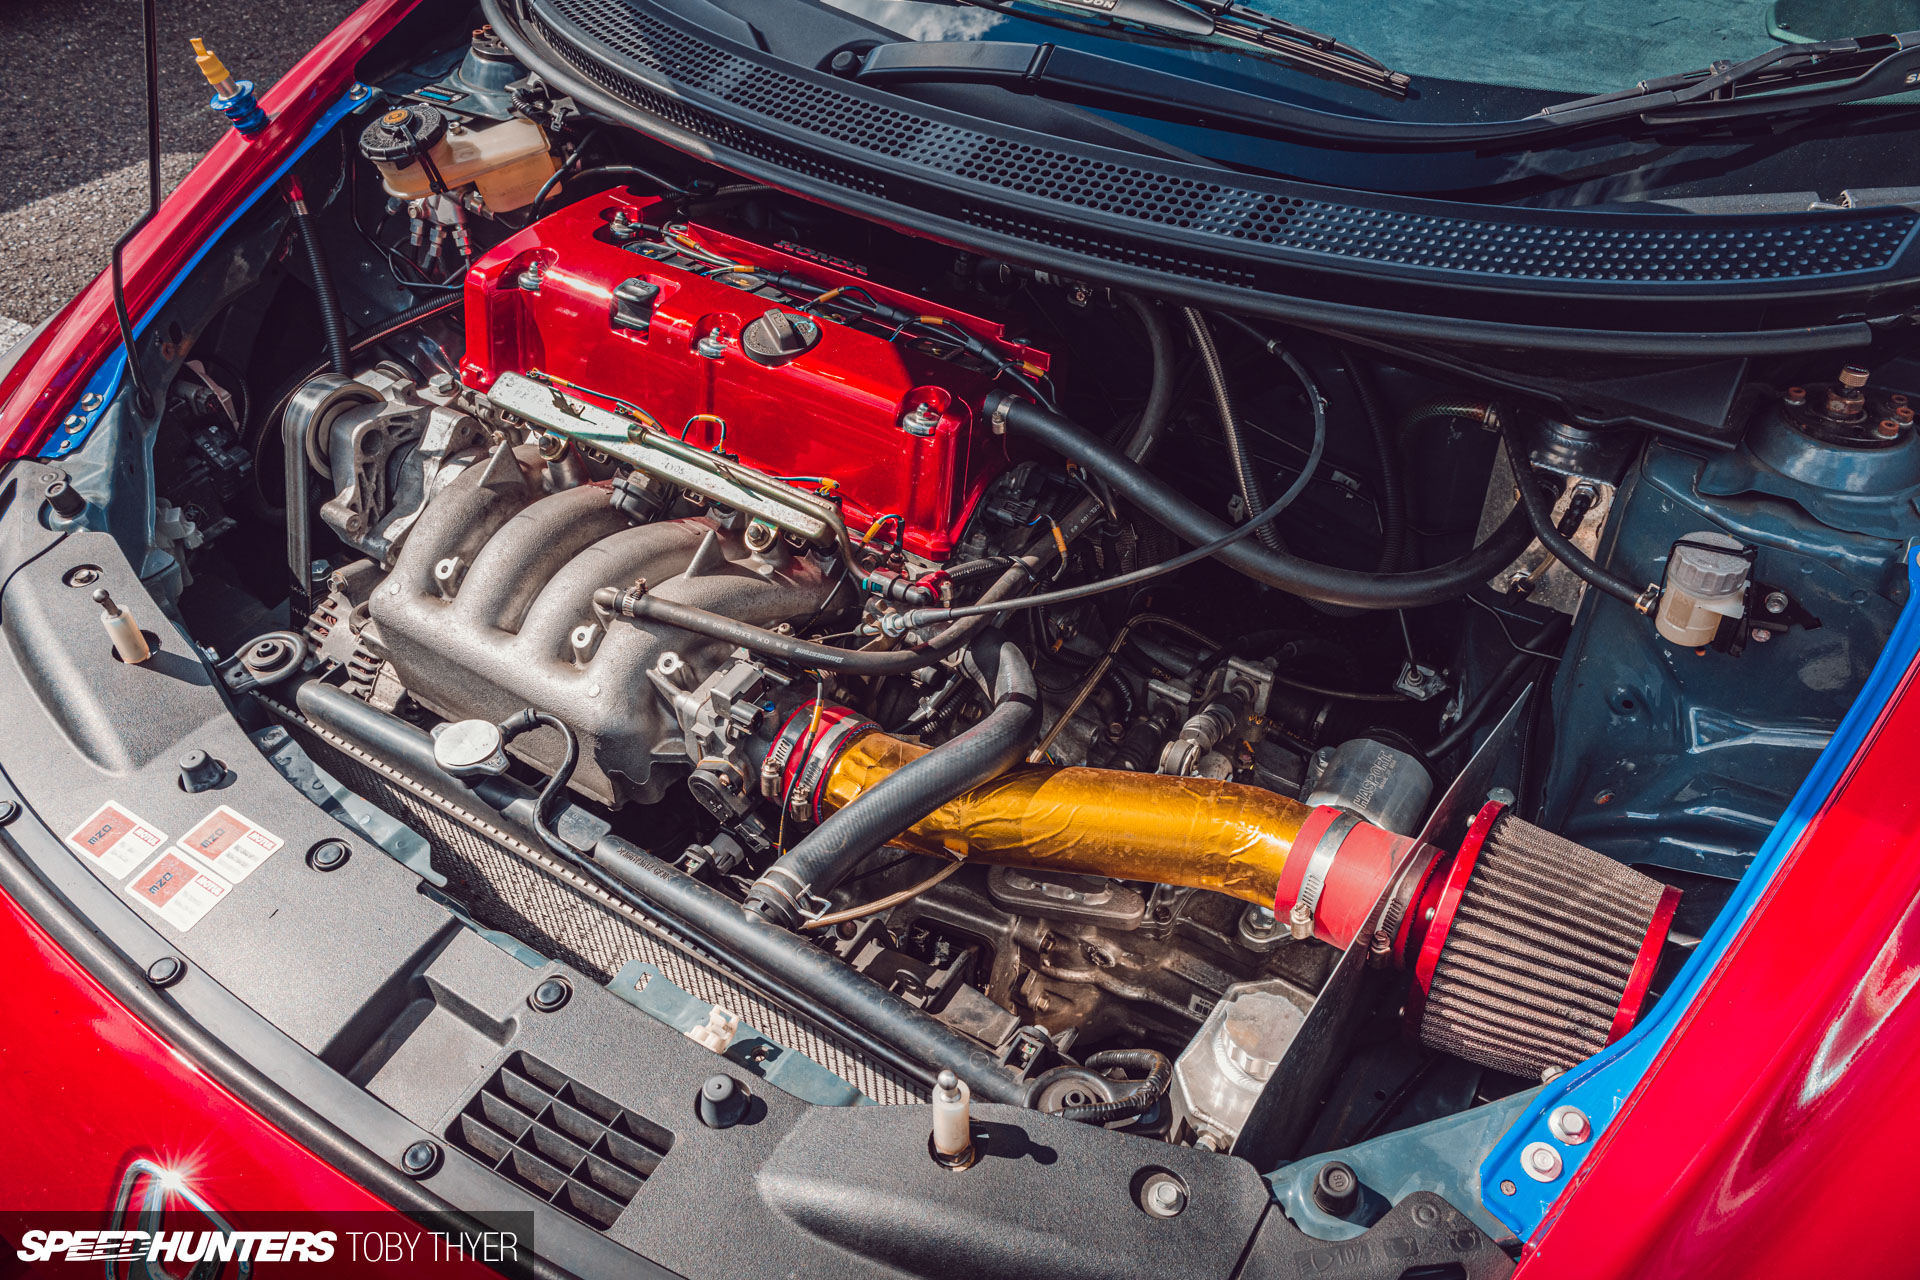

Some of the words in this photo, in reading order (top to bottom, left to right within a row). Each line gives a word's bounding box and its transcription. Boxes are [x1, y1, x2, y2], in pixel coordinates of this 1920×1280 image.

[773, 239, 869, 277] HONDA
[1353, 750, 1392, 810] HASPORT
[133, 826, 161, 847] MOTUL
[247, 830, 277, 851] MOTUL
[195, 874, 225, 897] MOTUL
